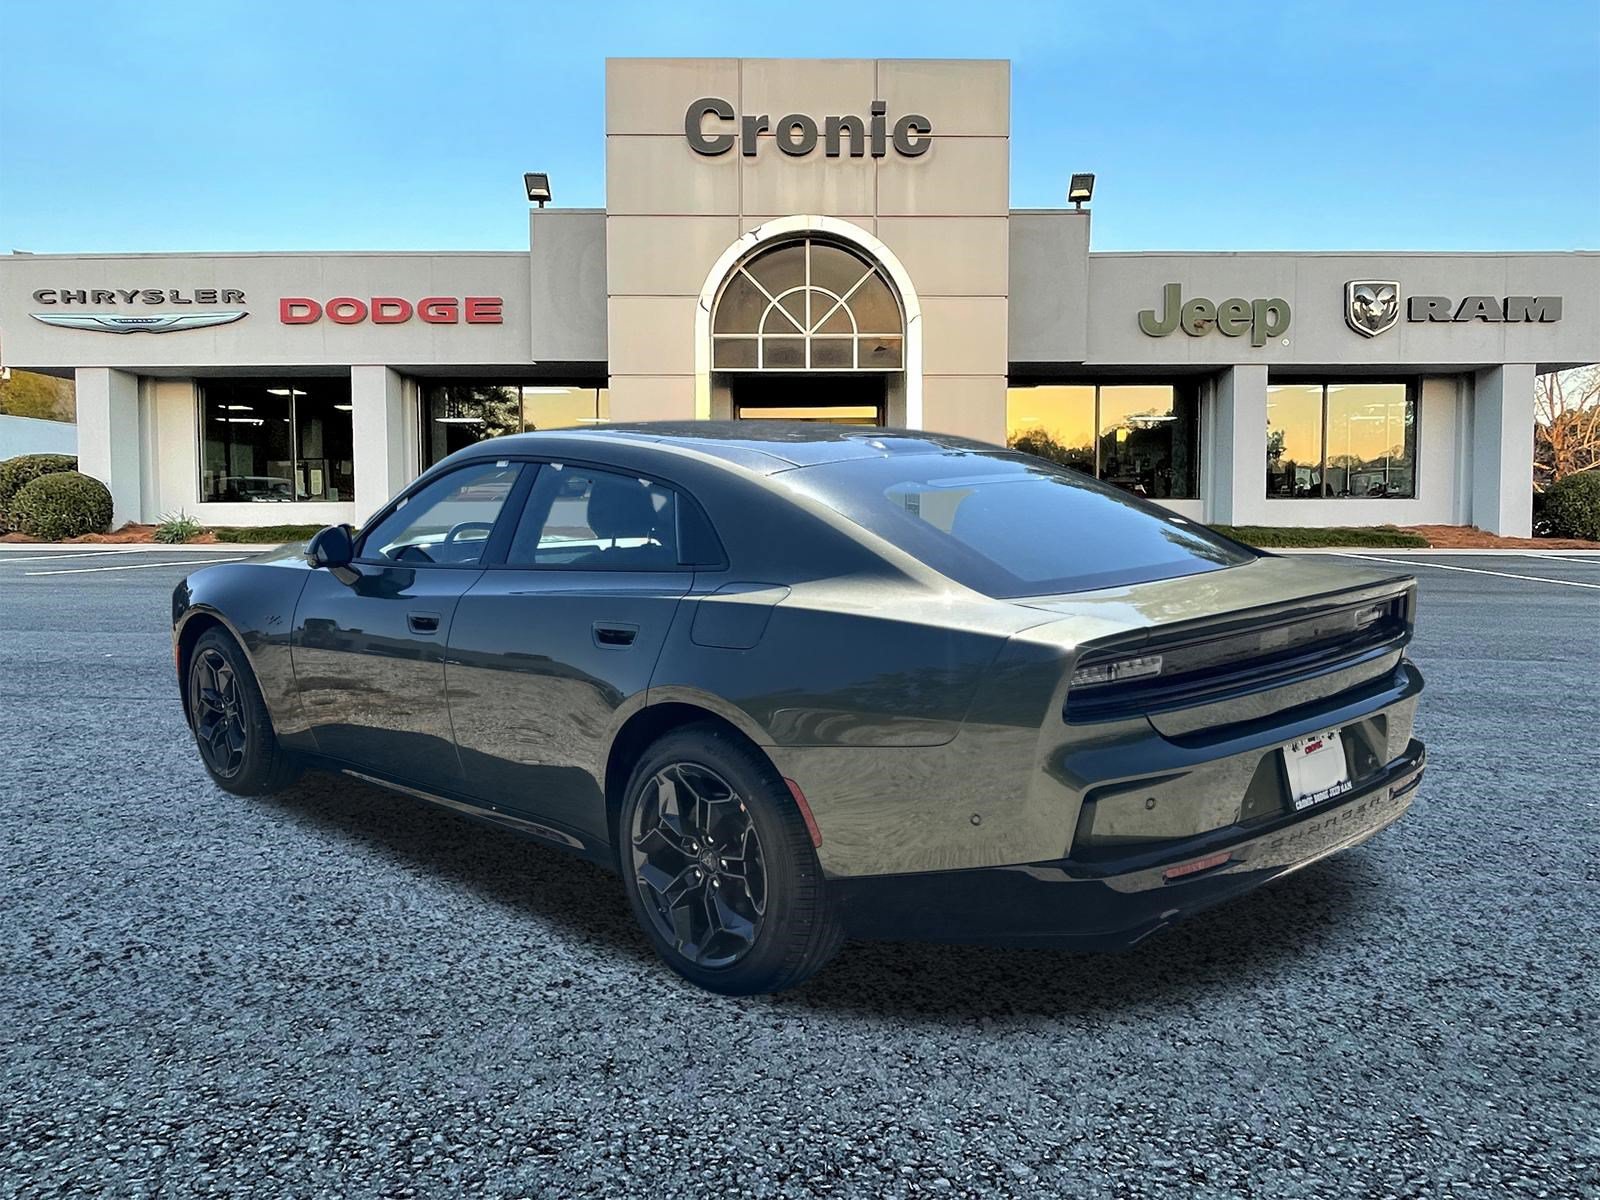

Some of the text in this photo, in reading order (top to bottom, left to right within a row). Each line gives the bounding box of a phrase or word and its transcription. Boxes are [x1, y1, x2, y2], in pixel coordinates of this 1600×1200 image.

[685, 97, 931, 157] Cronic
[32, 287, 247, 305] CHRYSLER
[280, 296, 503, 325] DODGE
[1407, 296, 1563, 323] RAM
[1138, 282, 1291, 347] Jeep
